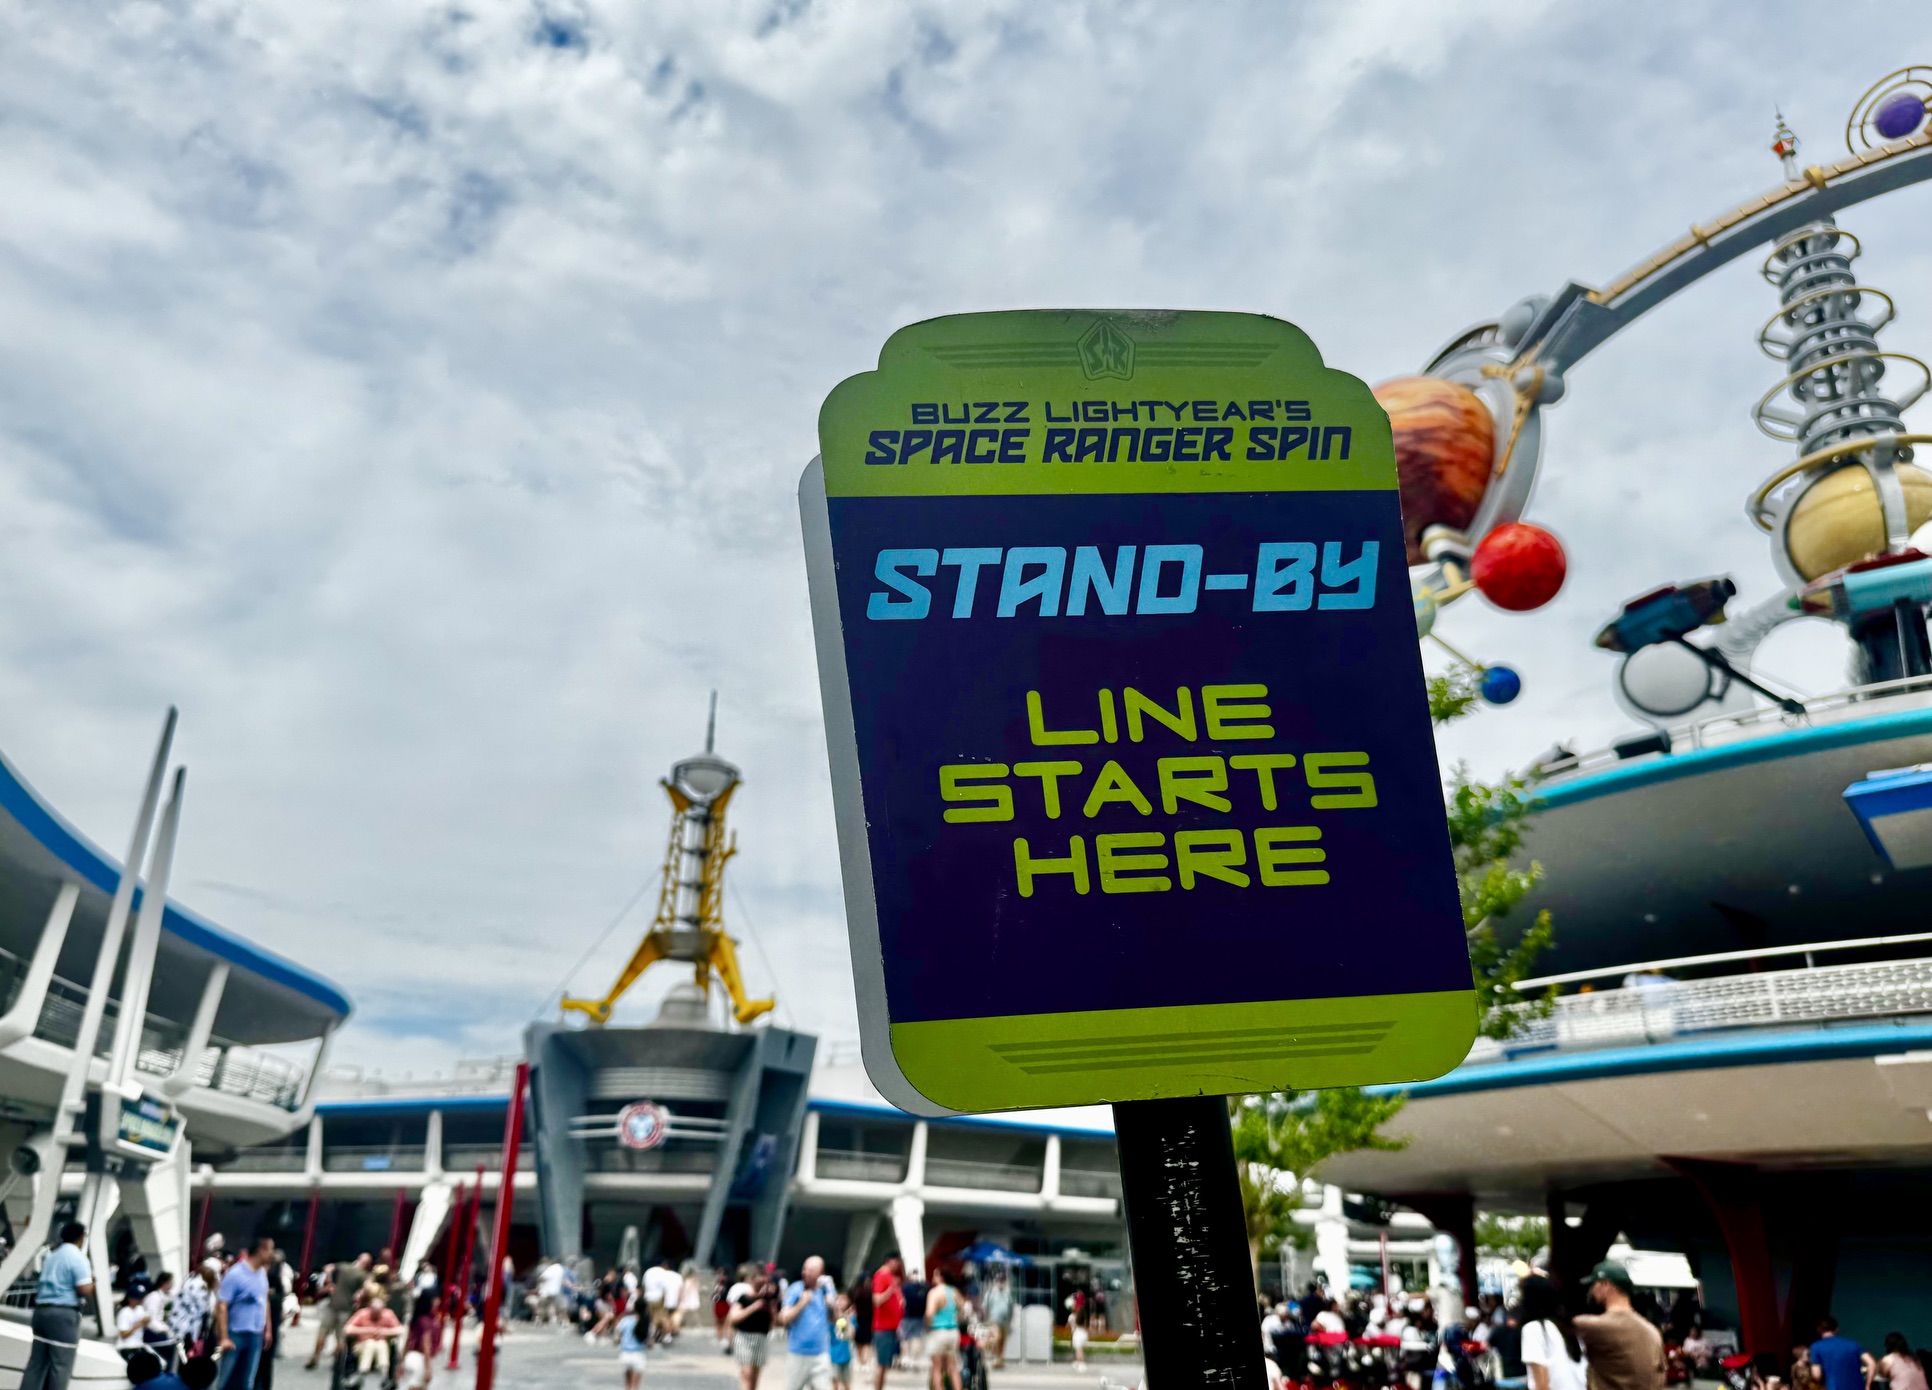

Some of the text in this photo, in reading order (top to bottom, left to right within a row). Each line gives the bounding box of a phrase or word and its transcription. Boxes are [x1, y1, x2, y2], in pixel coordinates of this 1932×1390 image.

[912, 400, 1311, 424] BUZZ LIGHTYEAR'S
[865, 427, 1352, 465] SPACE RANGER SPIN
[867, 541, 1379, 620] STAND-BY
[1027, 684, 1275, 745] LINE
[939, 752, 1377, 823] STARTS
[1014, 826, 1330, 897] HERE
